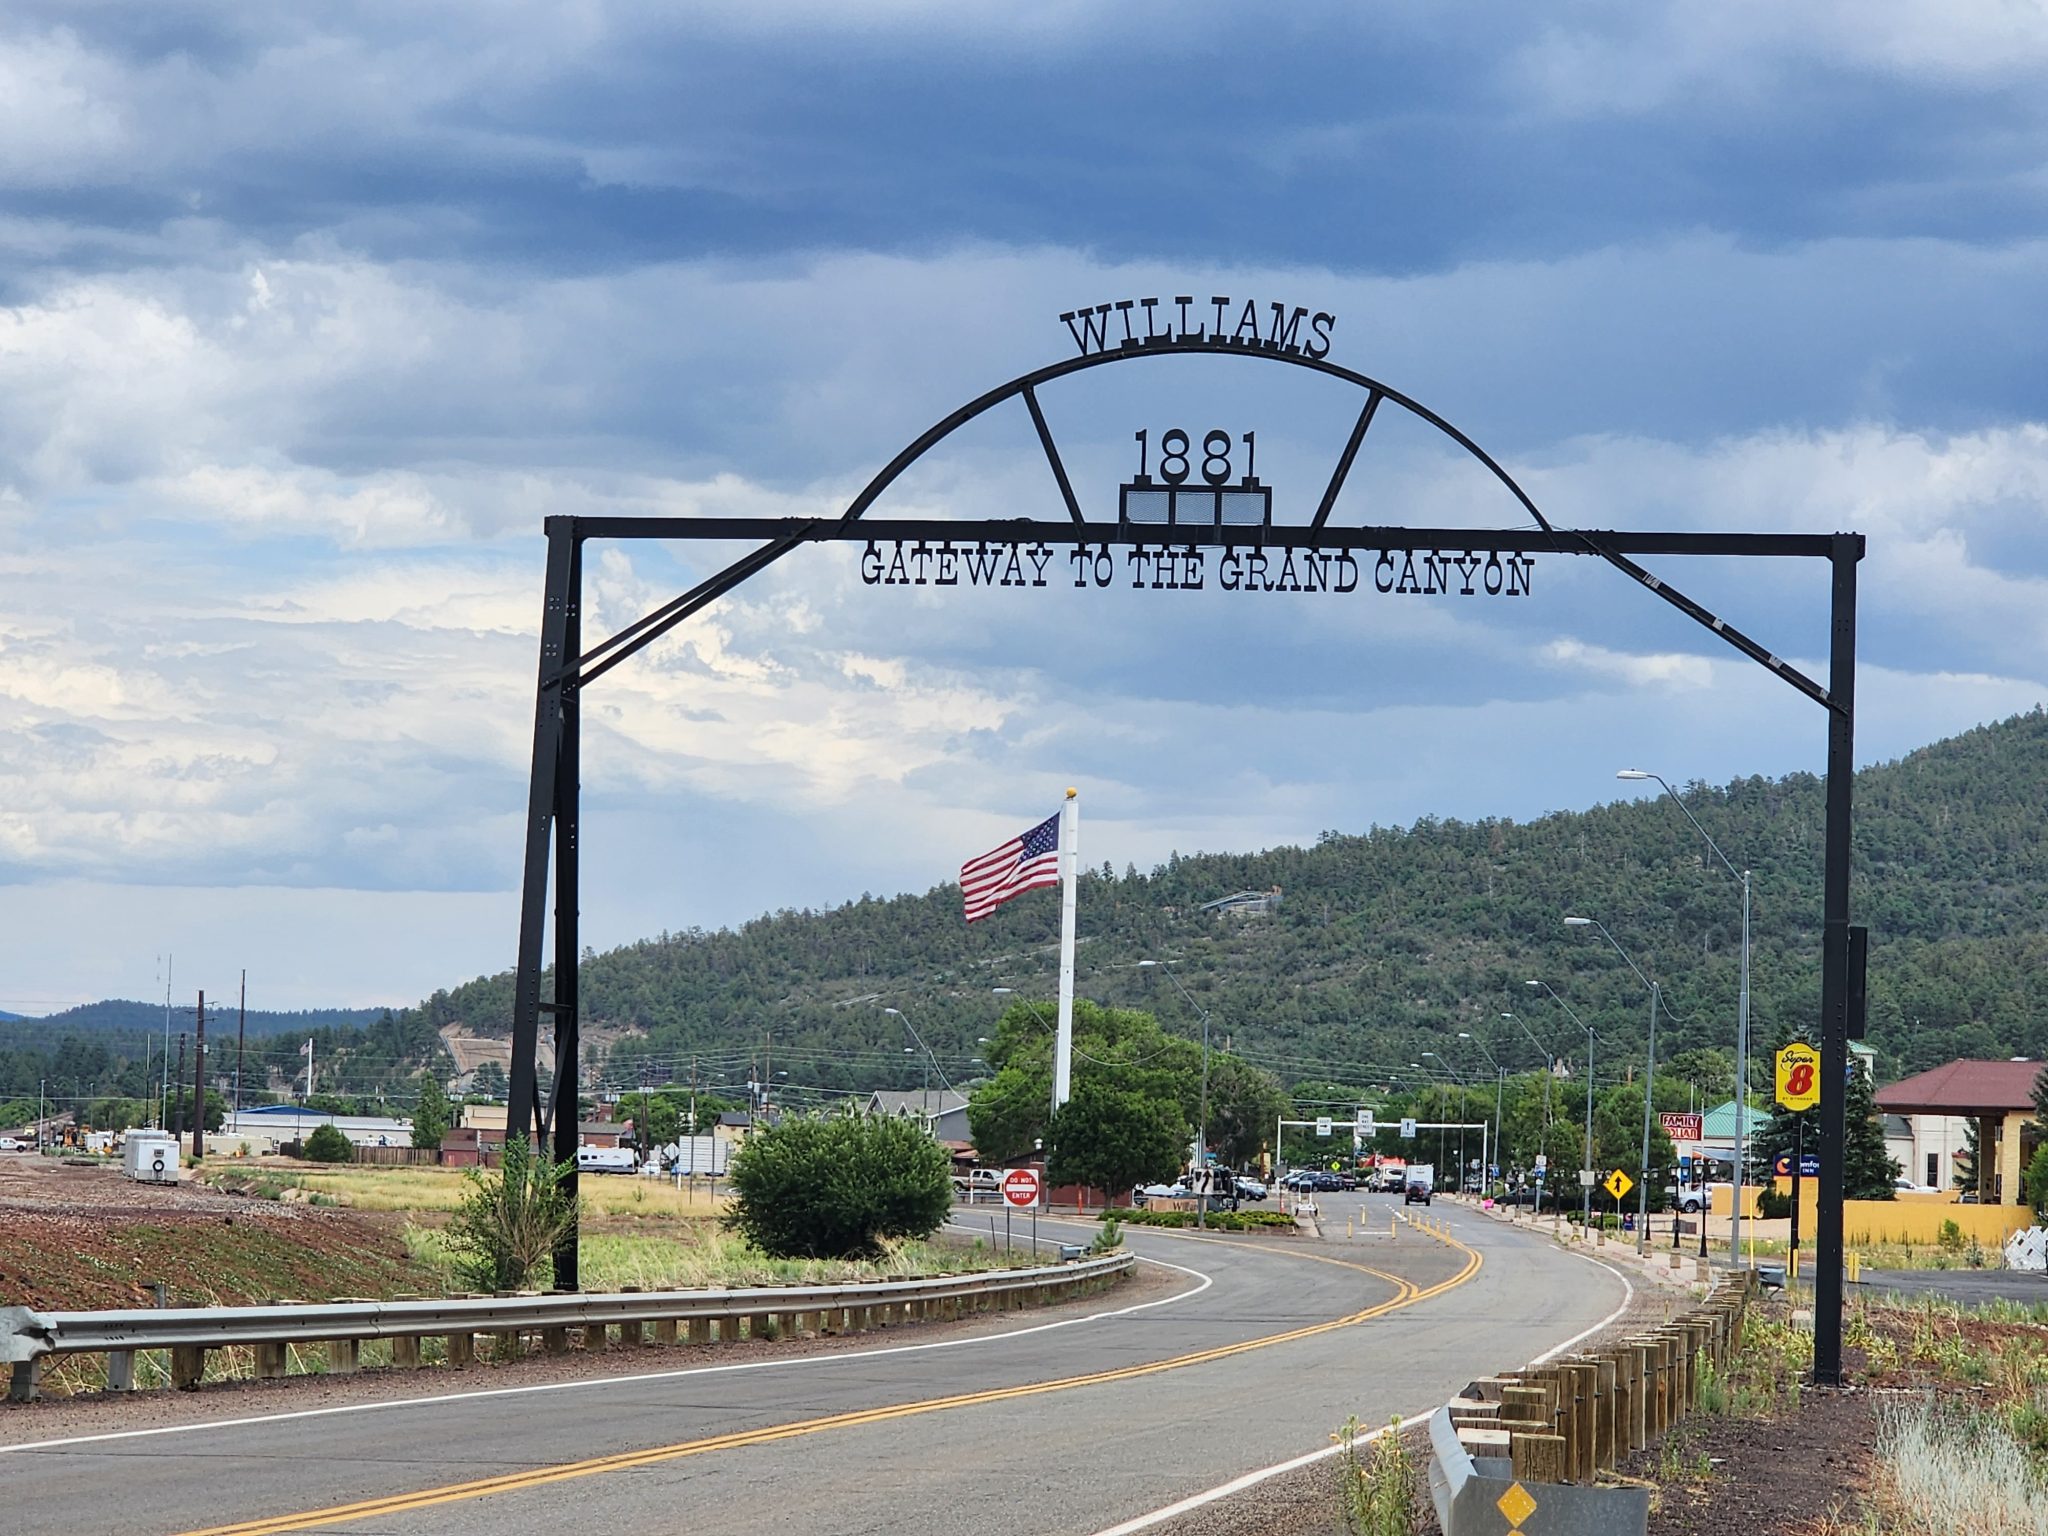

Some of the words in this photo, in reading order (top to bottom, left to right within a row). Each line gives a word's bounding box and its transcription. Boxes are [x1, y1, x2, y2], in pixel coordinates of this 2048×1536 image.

[1059, 296, 1336, 360] WILLIAMS
[1134, 428, 1260, 486] 1881
[861, 546, 1054, 586] GATEWAY
[1070, 548, 1113, 587] TO
[1128, 550, 1204, 589] THE
[1219, 552, 1359, 593] GRAND
[1375, 554, 1535, 596] CANYON
[1781, 1050, 1814, 1070] Super
[1785, 1064, 1814, 1096] 8
[1663, 1114, 1700, 1127] FAMILY
